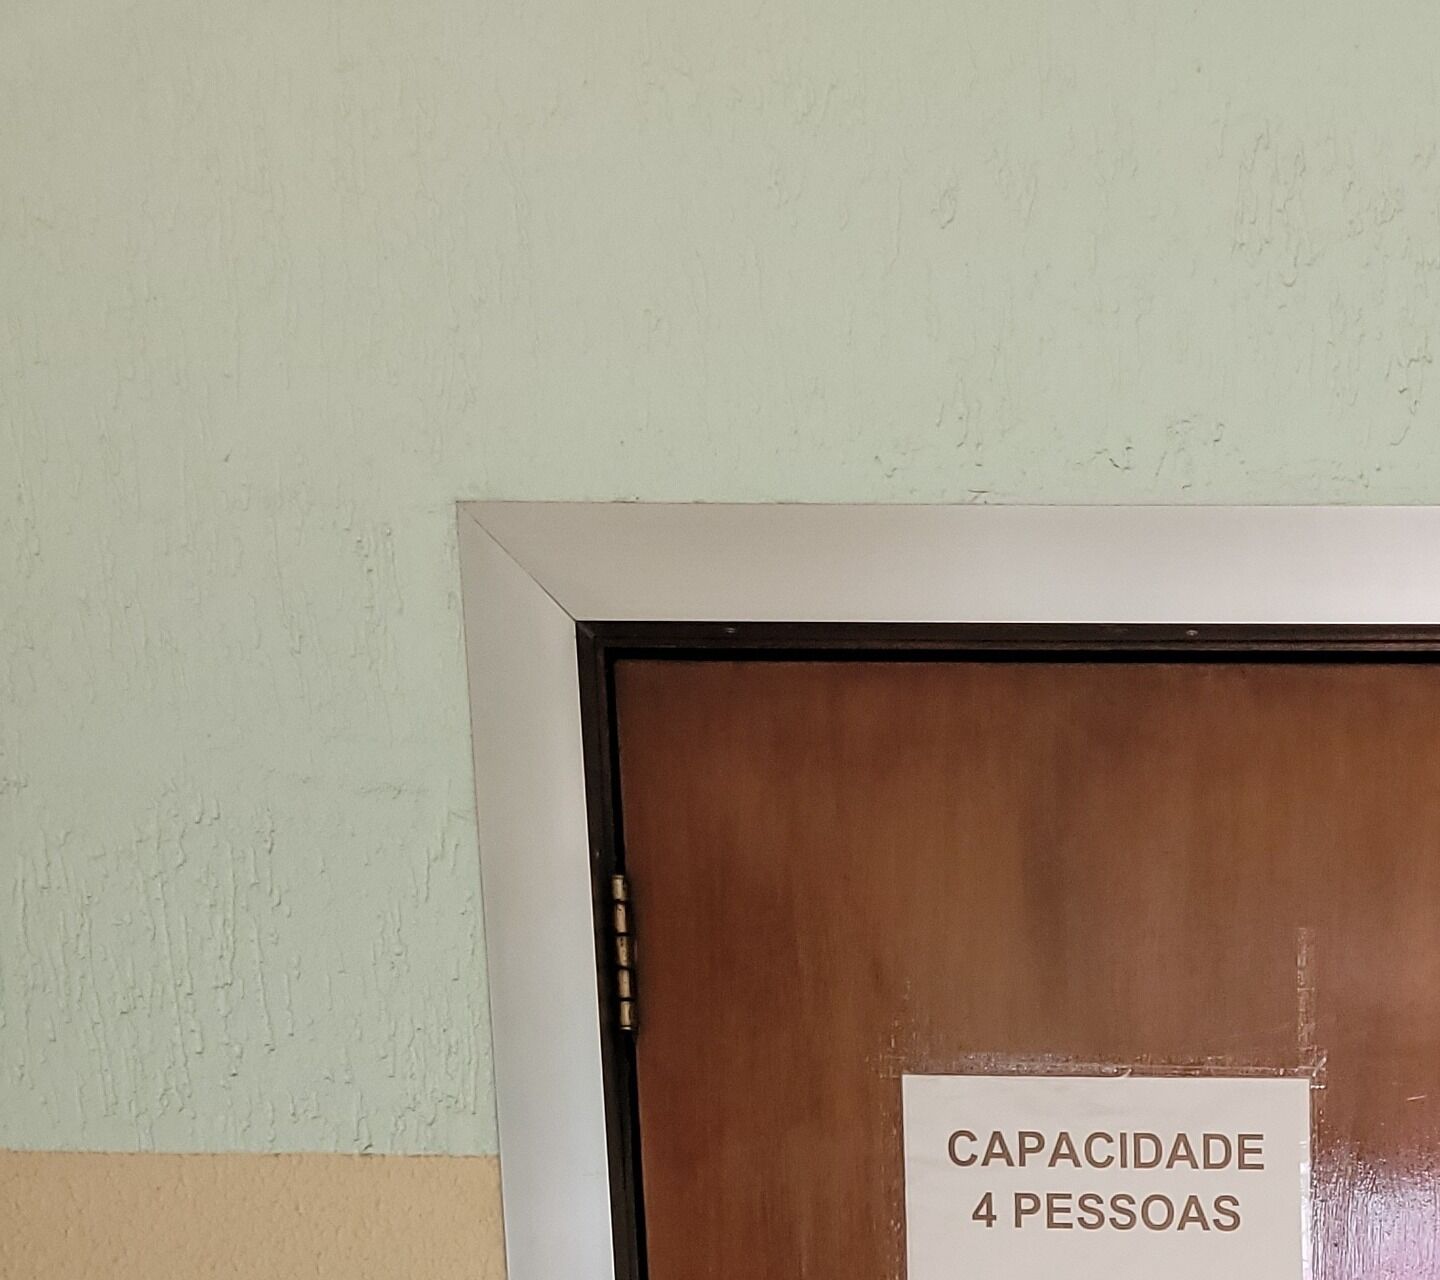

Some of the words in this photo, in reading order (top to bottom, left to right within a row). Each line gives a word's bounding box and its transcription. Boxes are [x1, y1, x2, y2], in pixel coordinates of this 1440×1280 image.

[947, 1130, 1265, 1171] CAPACIDADE
[971, 1192, 997, 1228] 4
[1014, 1192, 1241, 1232] PESSOAS
